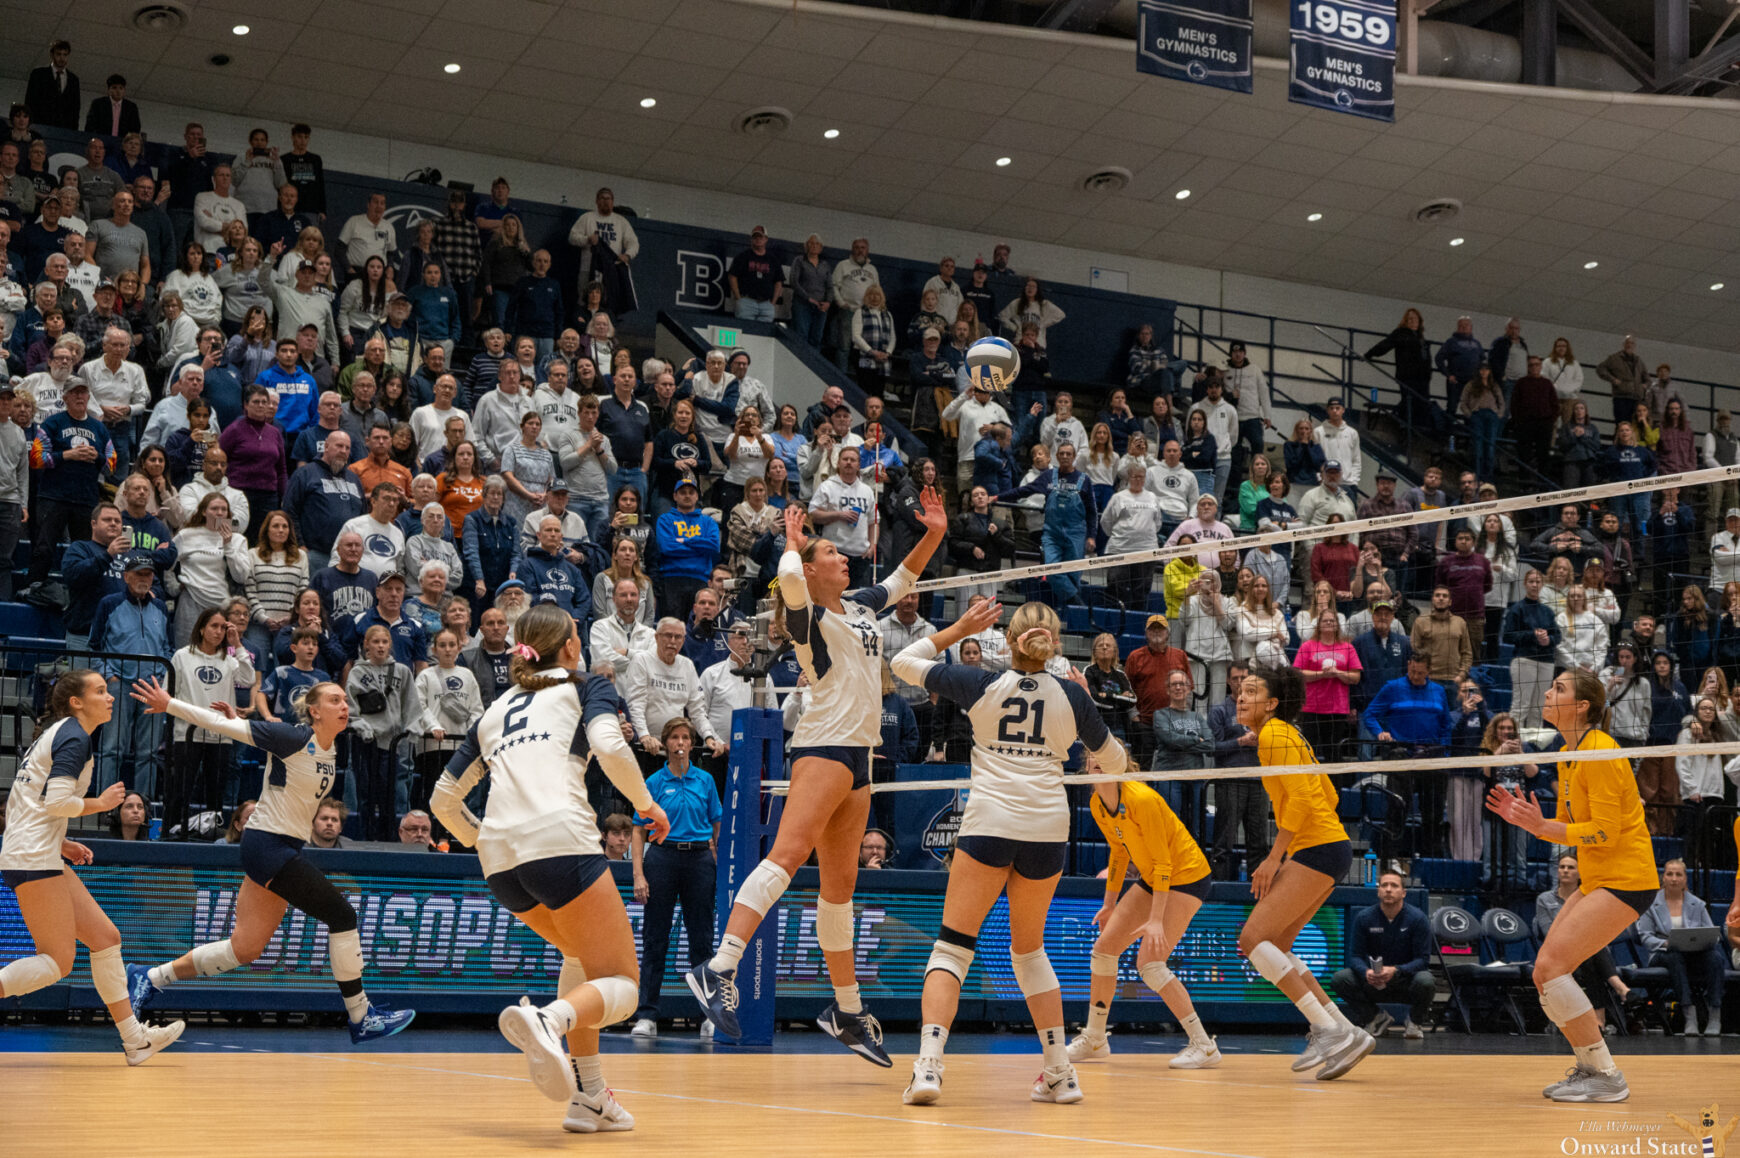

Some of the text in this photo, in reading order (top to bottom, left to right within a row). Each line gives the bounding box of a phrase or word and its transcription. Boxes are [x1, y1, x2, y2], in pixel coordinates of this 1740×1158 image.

[1299, 1, 1390, 45] 1959
[1178, 27, 1217, 46] MEN'S
[1156, 38, 1237, 64] GYMNASTICS
[1326, 57, 1363, 75] MEN'S
[1307, 66, 1382, 93] GYMNASTICS
[596, 221, 615, 232] WE
[718, 329, 736, 346] EXIT
[39, 389, 58, 400] PENN
[543, 404, 559, 416] PENN
[62, 427, 96, 442] PENN STATE
[1633, 476, 1683, 489] VOLLEYBALL CHAMPIONSHIP
[673, 520, 702, 538] Pitt
[1194, 530, 1225, 541] PENN
[541, 583, 576, 593] PENN STATE
[333, 586, 354, 611] PENN
[861, 630, 879, 656] 44
[651, 679, 687, 693] PENN STATE
[502, 691, 536, 738] 2
[998, 697, 1046, 745] 21
[316, 762, 334, 776] PSU
[315, 778, 329, 799] 9
[753, 937, 763, 966] sports
[753, 966, 763, 1000] imports
